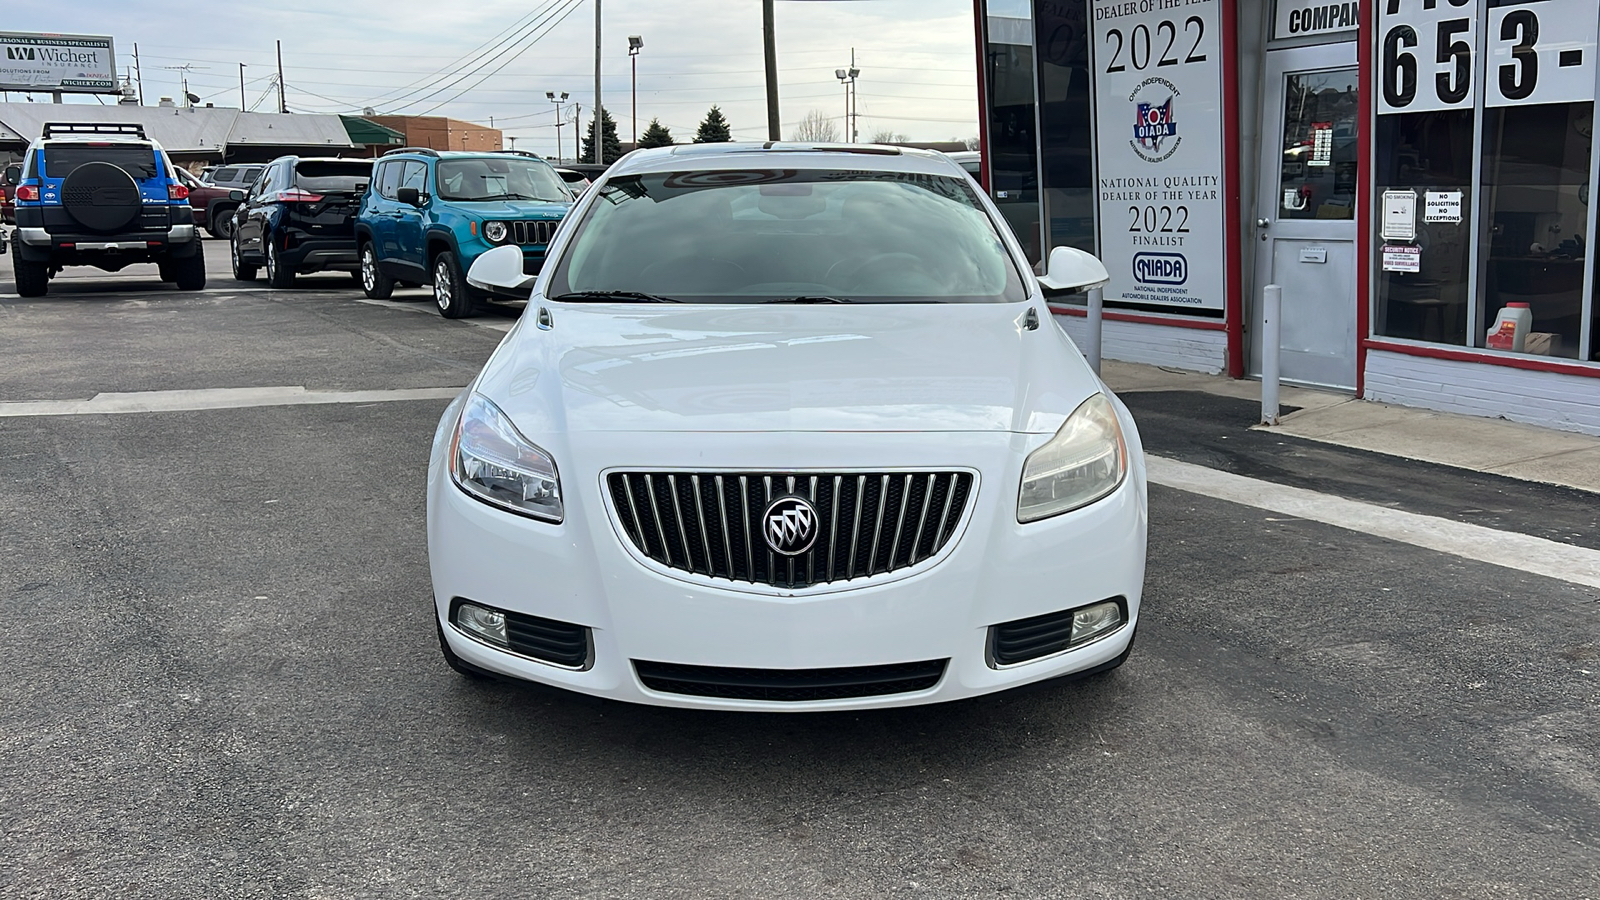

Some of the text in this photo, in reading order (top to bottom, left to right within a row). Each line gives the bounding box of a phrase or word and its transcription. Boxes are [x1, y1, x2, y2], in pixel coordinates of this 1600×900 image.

[1096, 1, 1138, 20] DEALER
[1140, 0, 1154, 13] OF
[1106, 16, 1206, 73] 2022
[37, 47, 98, 63] Wichert
[1128, 76, 1181, 102] OHIO INDEPENDENT
[1138, 124, 1170, 138] OIADA
[1101, 176, 1218, 189] NATIONAL QUALITY
[1103, 190, 1217, 201] DEALER OF THE YEAR
[1128, 205, 1190, 233] 2022
[1133, 235, 1184, 246] FINALIST
[1137, 259, 1182, 278] NIADA
[1150, 294, 1169, 302] DEALERS
[1170, 296, 1202, 304] ASSOCIATION
